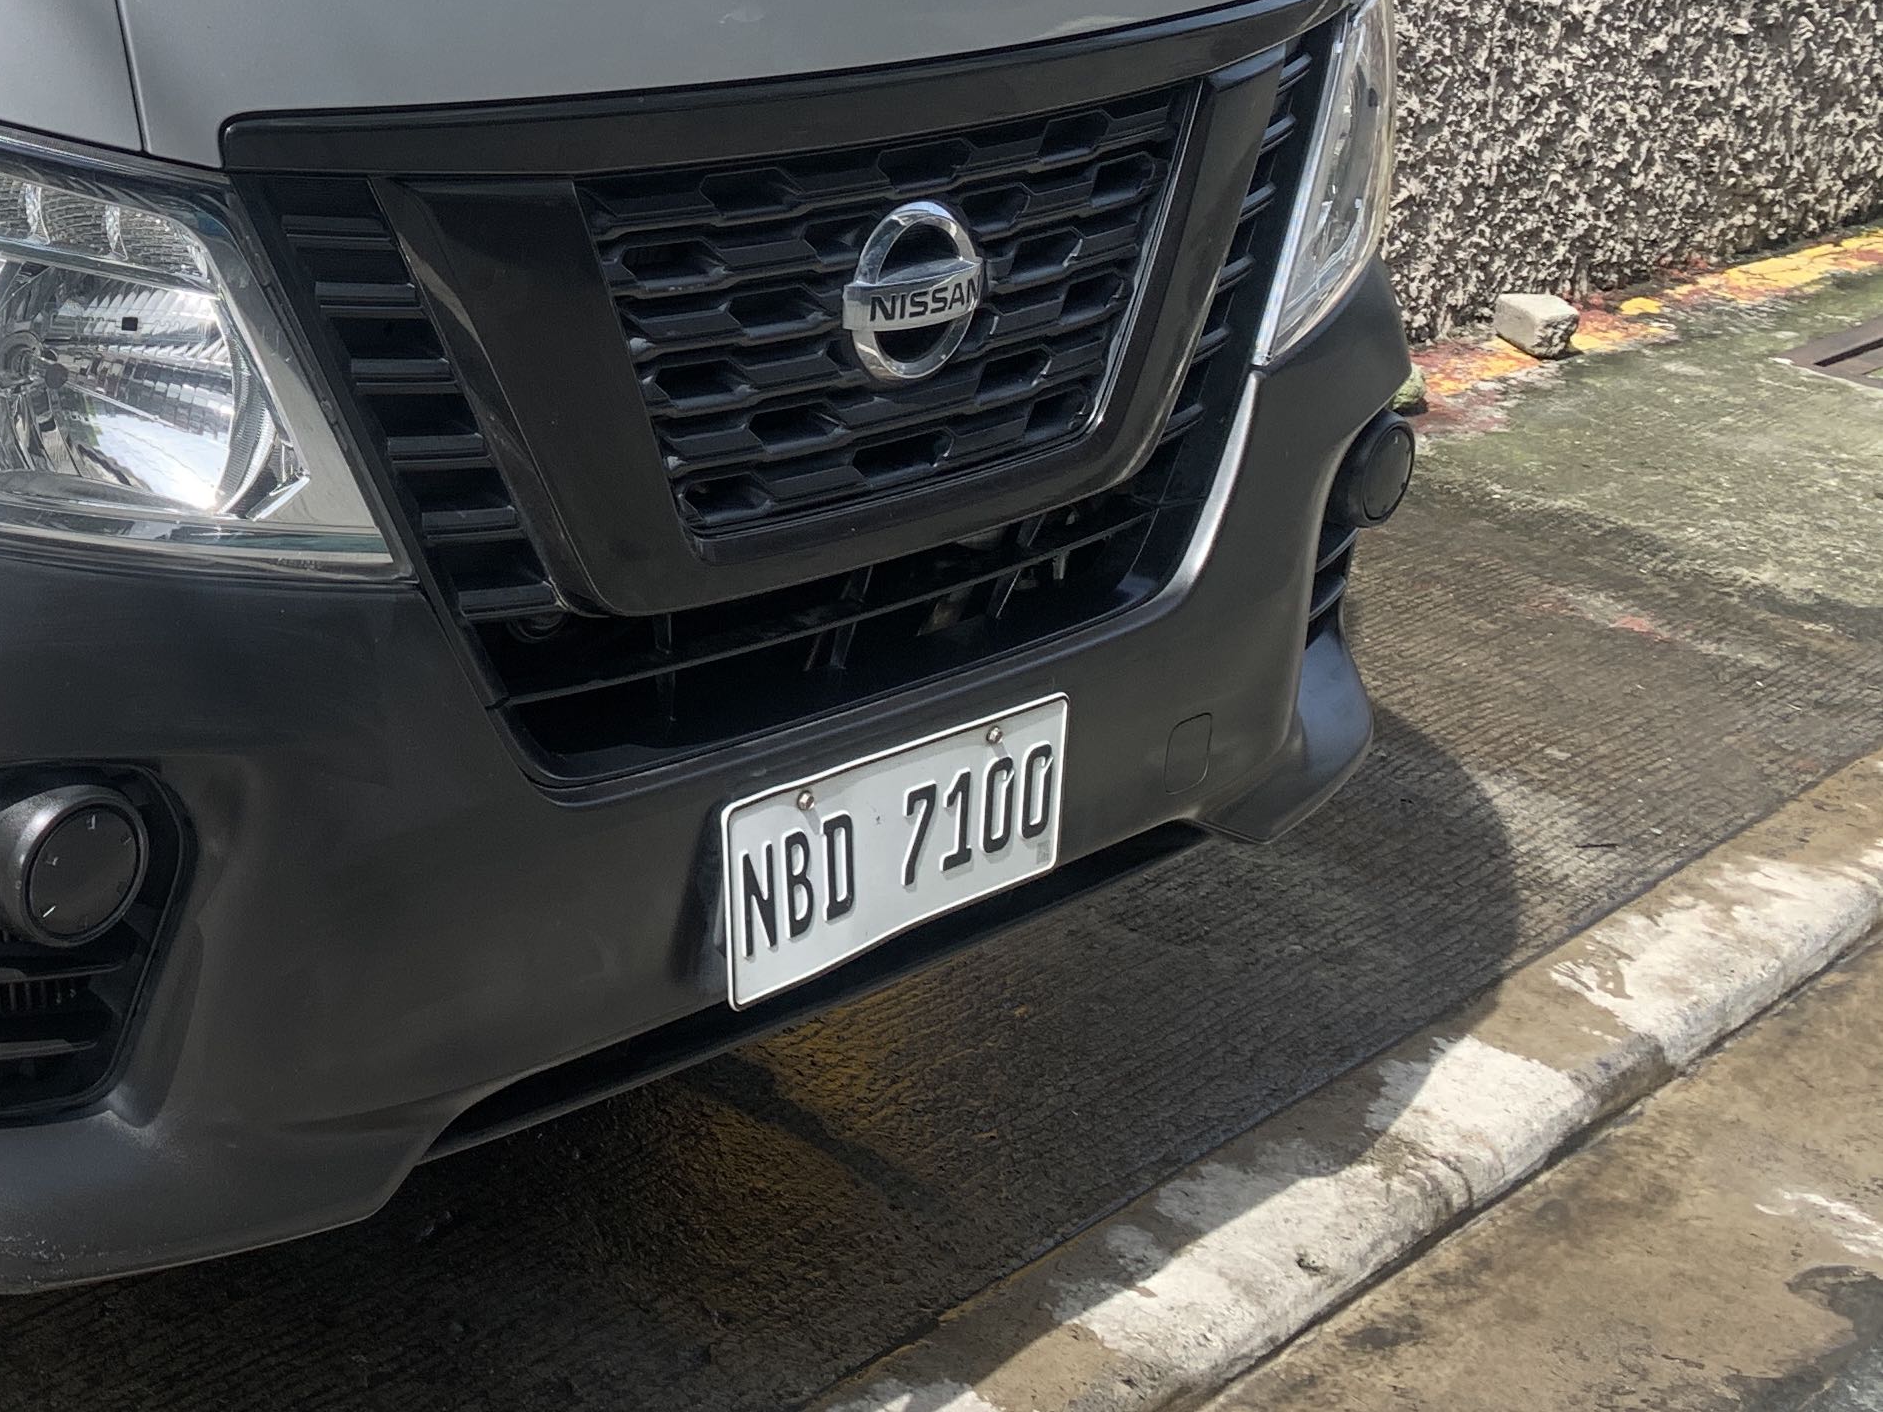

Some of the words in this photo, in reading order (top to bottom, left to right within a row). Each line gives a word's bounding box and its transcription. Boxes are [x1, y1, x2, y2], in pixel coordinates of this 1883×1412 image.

[869, 275, 981, 323] NISSAN
[740, 809, 855, 958] NBD
[901, 741, 1055, 887] 7100
